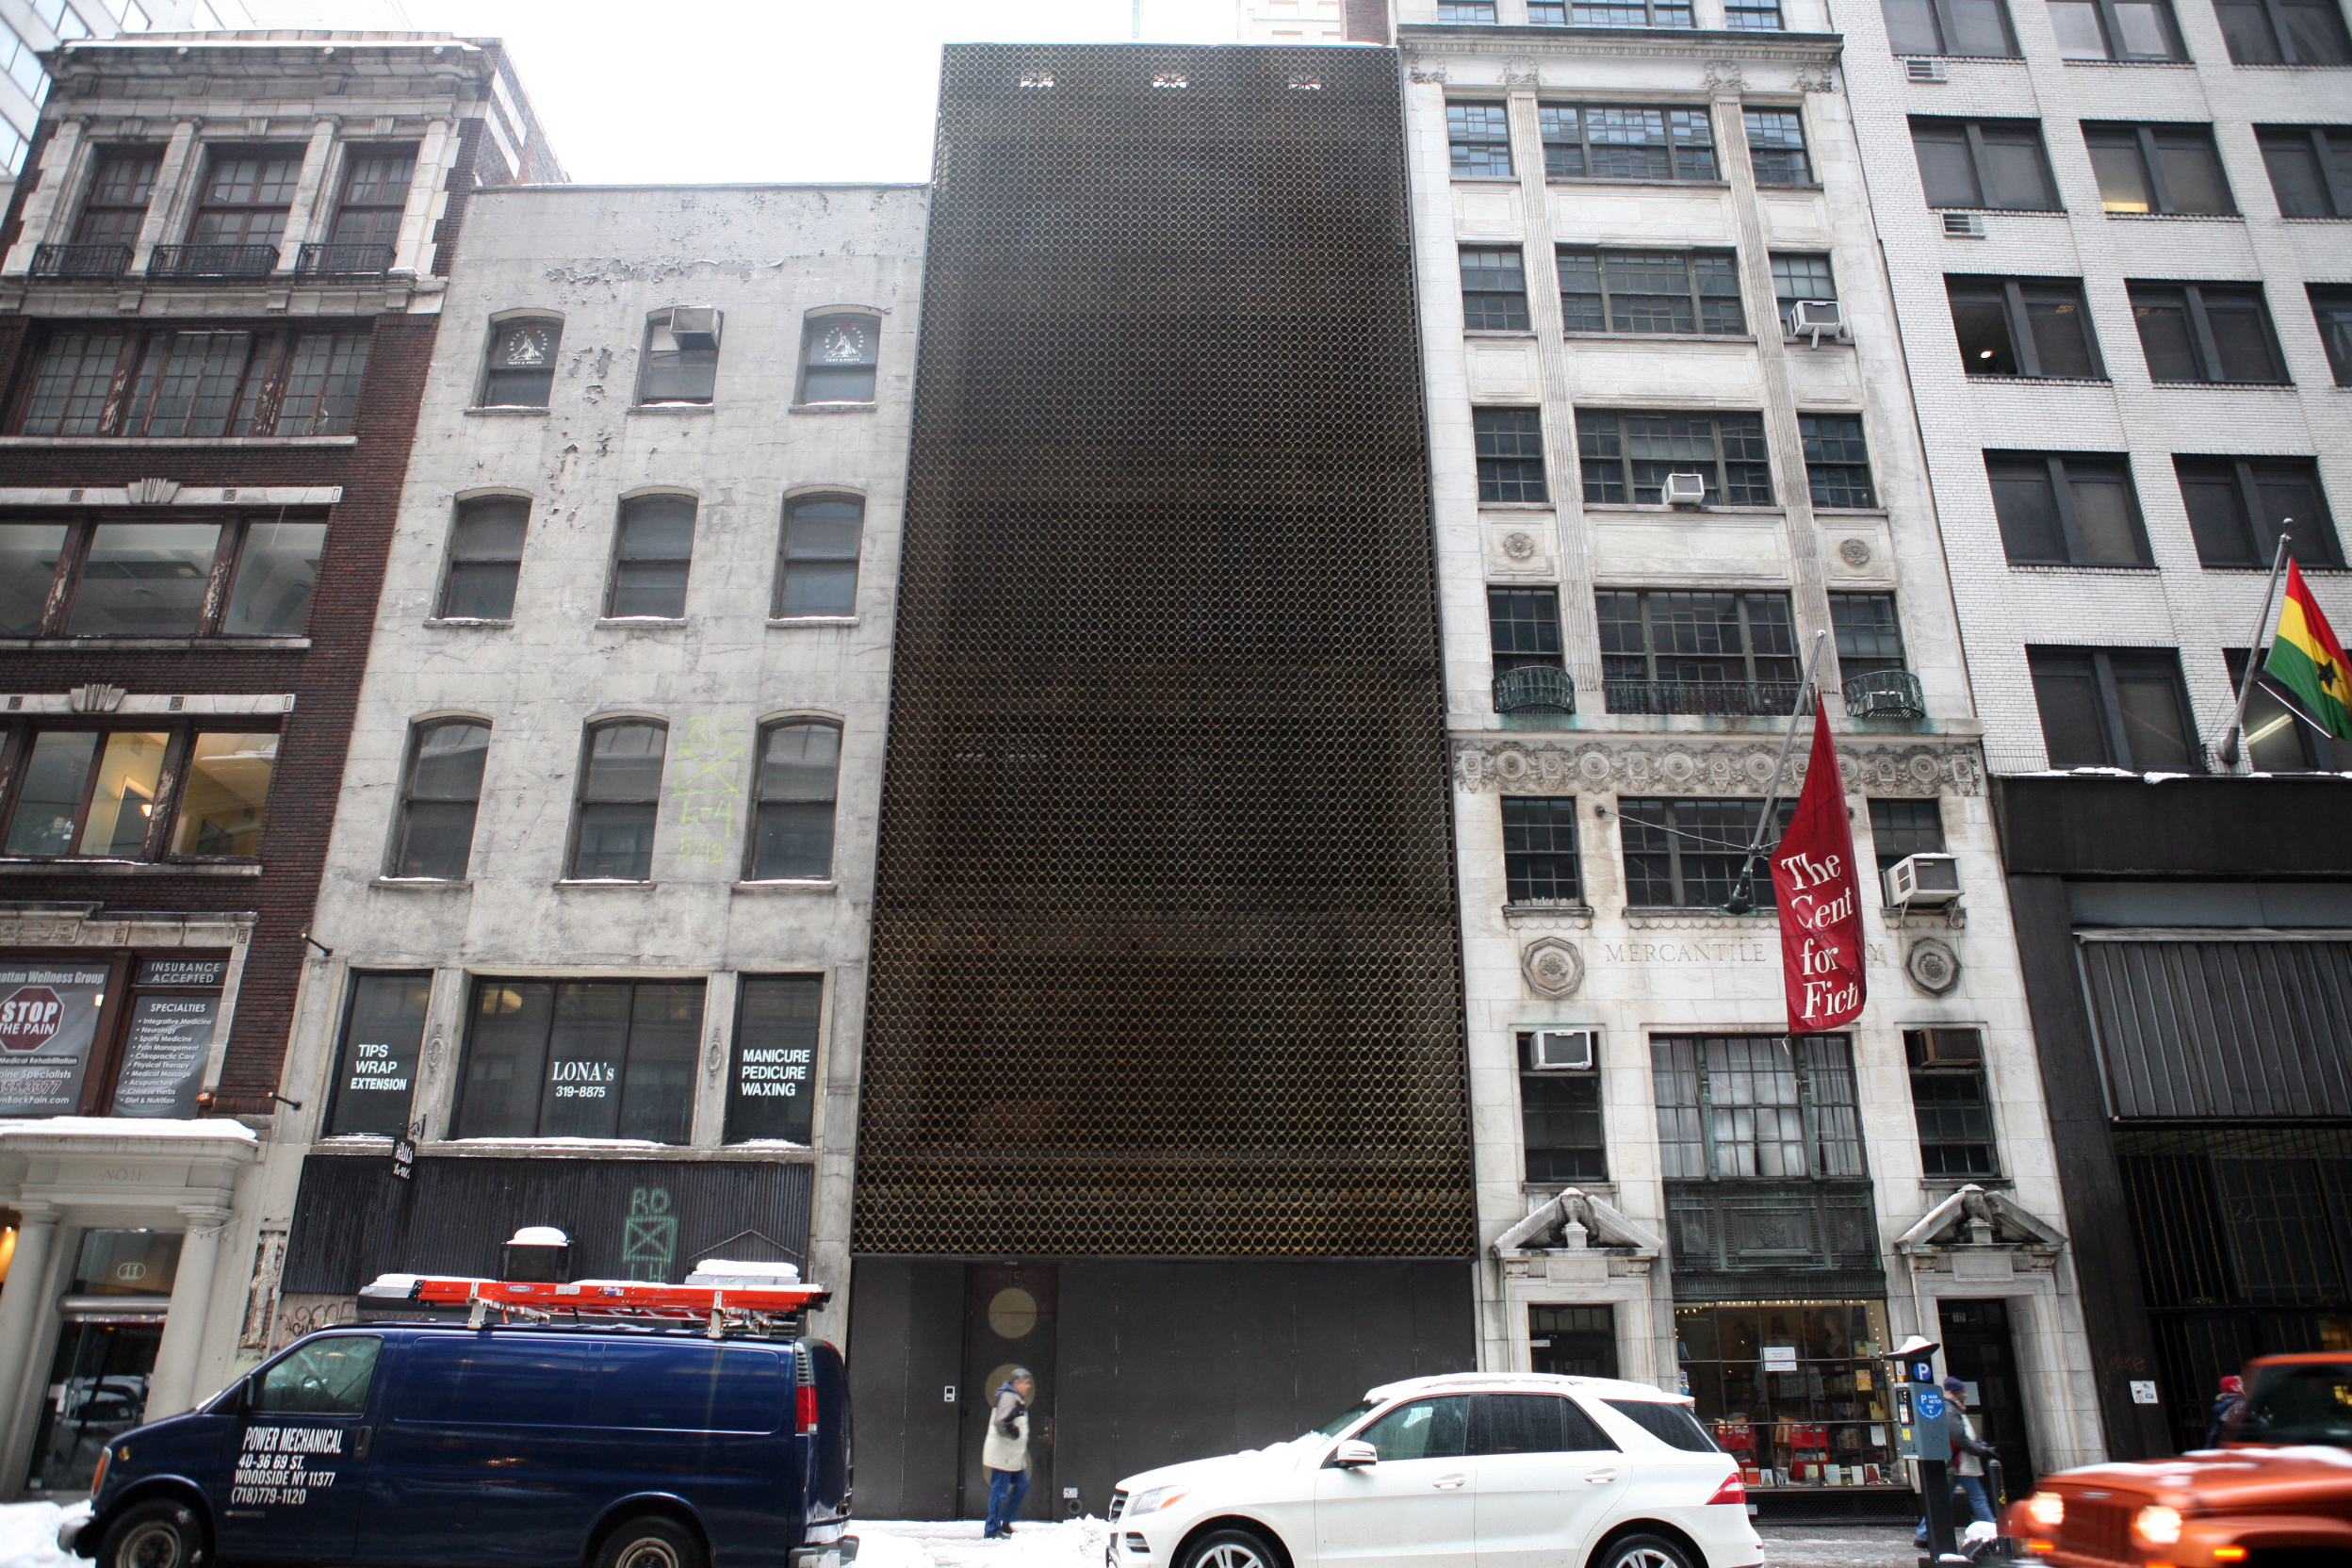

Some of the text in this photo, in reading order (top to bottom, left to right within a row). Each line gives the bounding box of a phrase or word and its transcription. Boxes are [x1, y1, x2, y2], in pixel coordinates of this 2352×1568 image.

[1781, 852, 1840, 891] The
[1605, 943, 1767, 962] MERCANTILE
[1801, 938, 1839, 976] for
[151, 962, 220, 972] INSURANCE
[0, 971, 105, 985] attan Wellness Group
[152, 973, 214, 984] ACCEPTED
[2, 1001, 58, 1023] STOP
[151, 1003, 206, 1013] SPECIALTIES
[0, 1022, 56, 1035] THE PAIN
[143, 1018, 179, 1026] Integrative
[141, 1026, 177, 1035] Neurology
[153, 1044, 200, 1053] Management
[358, 1043, 389, 1058] TIPS
[743, 1048, 811, 1063] MANICURE
[0, 1056, 77, 1065] Medical Rehabilitation
[136, 1053, 177, 1061] Chiropractic
[133, 1061, 190, 1070] Physical Therapy
[355, 1060, 398, 1074] WRAP
[551, 1061, 615, 1082] LONA's
[742, 1065, 808, 1080] PEDICURE
[22, 1070, 72, 1080] Specialists
[160, 1070, 192, 1079] Massage
[350, 1077, 408, 1090] EXTENSION
[741, 1082, 797, 1097] WAXING
[555, 1085, 607, 1098] 319-8875
[123, 1265, 139, 1280] 11
[1918, 1363, 1929, 1380] P
[1920, 1395, 1927, 1404] P
[242, 1426, 344, 1454] POWER MECHANICAL
[238, 1453, 305, 1470] 40-36 69 ST.
[235, 1469, 336, 1487] WOODSIDE NY 11377
[231, 1486, 306, 1505] (718)779-1120
